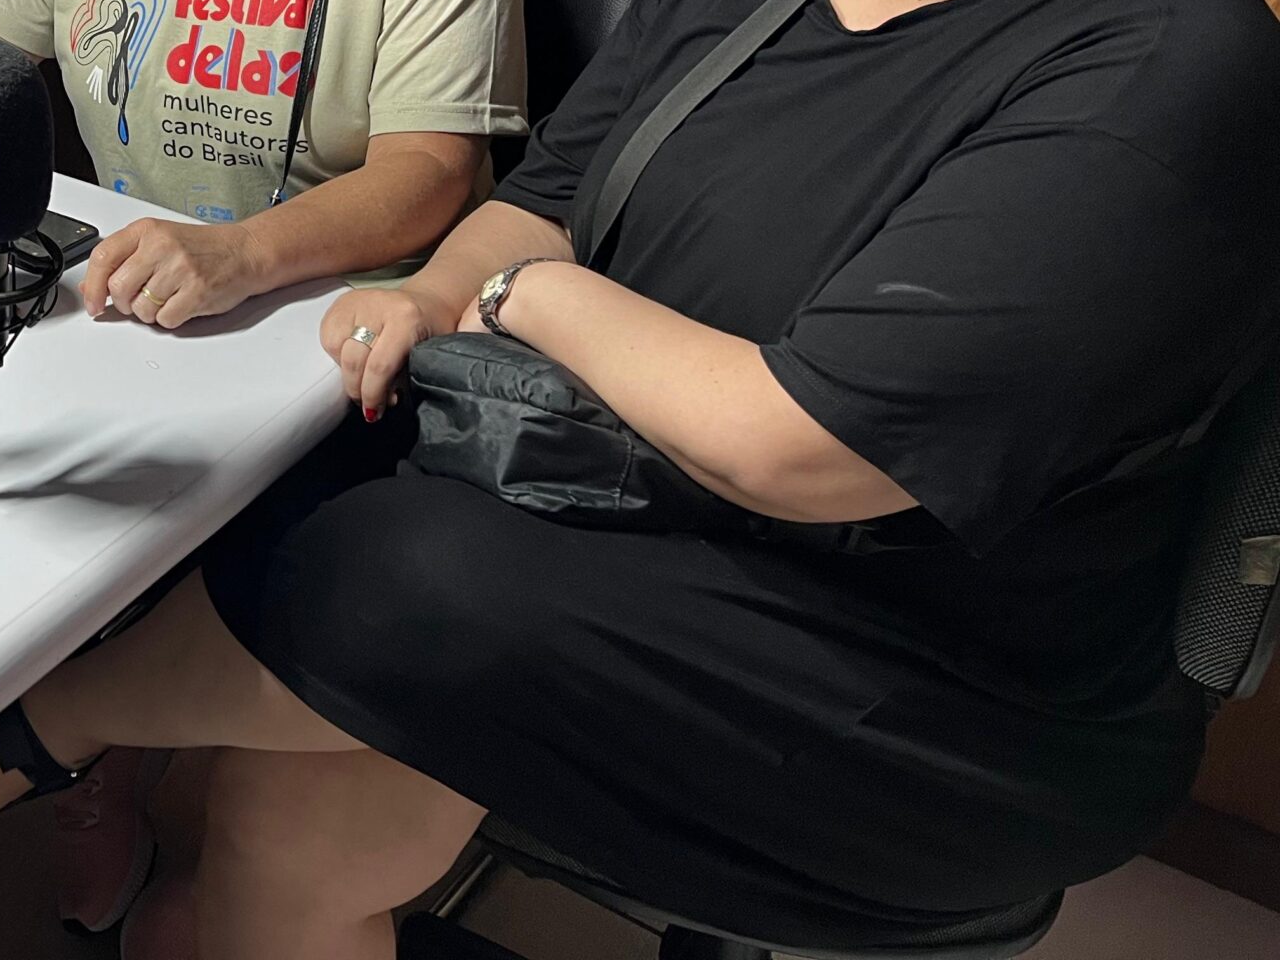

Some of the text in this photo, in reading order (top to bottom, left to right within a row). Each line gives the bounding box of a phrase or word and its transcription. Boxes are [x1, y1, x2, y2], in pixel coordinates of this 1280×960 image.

[164, 94, 273, 126] mulheres
[164, 140, 264, 168] do Brasil
